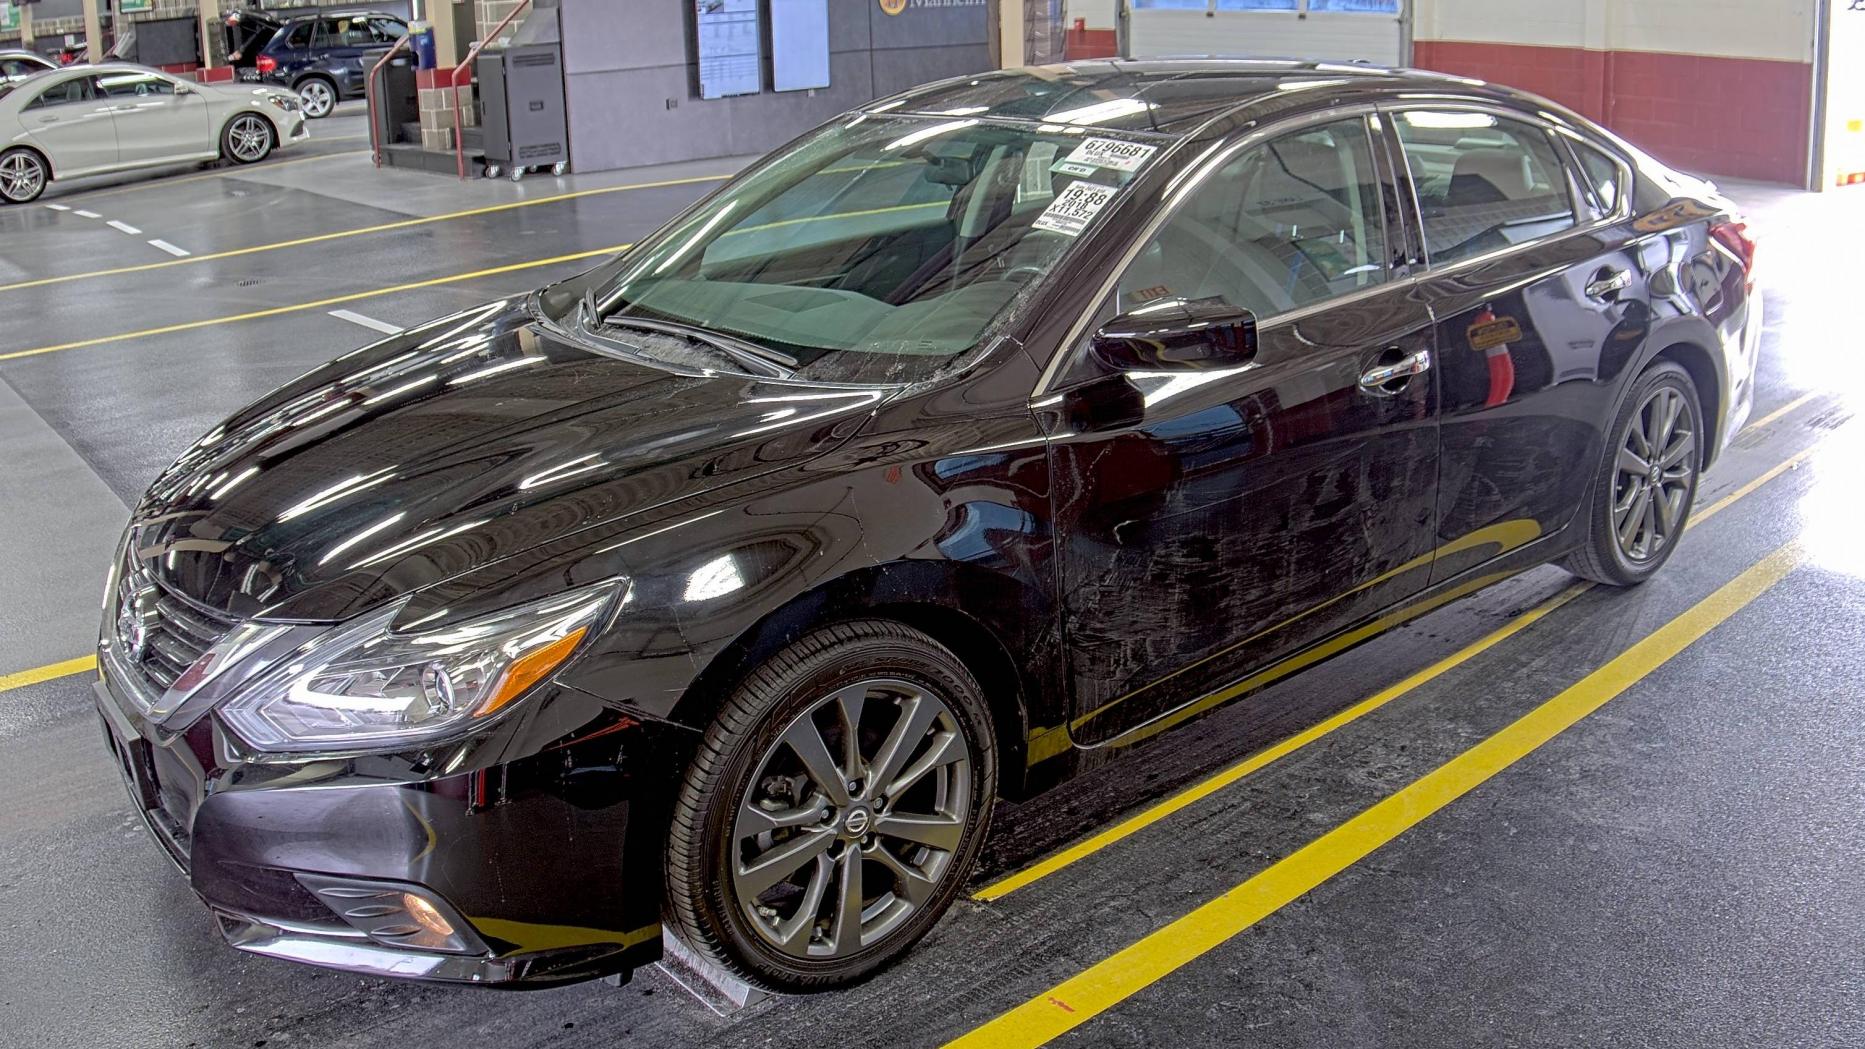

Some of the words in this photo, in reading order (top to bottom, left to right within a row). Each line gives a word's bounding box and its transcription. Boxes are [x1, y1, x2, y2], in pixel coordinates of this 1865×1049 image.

[1085, 140, 1151, 159] 6796681
[1061, 199, 1089, 210] 2018
[1064, 189, 1108, 206] 19:88
